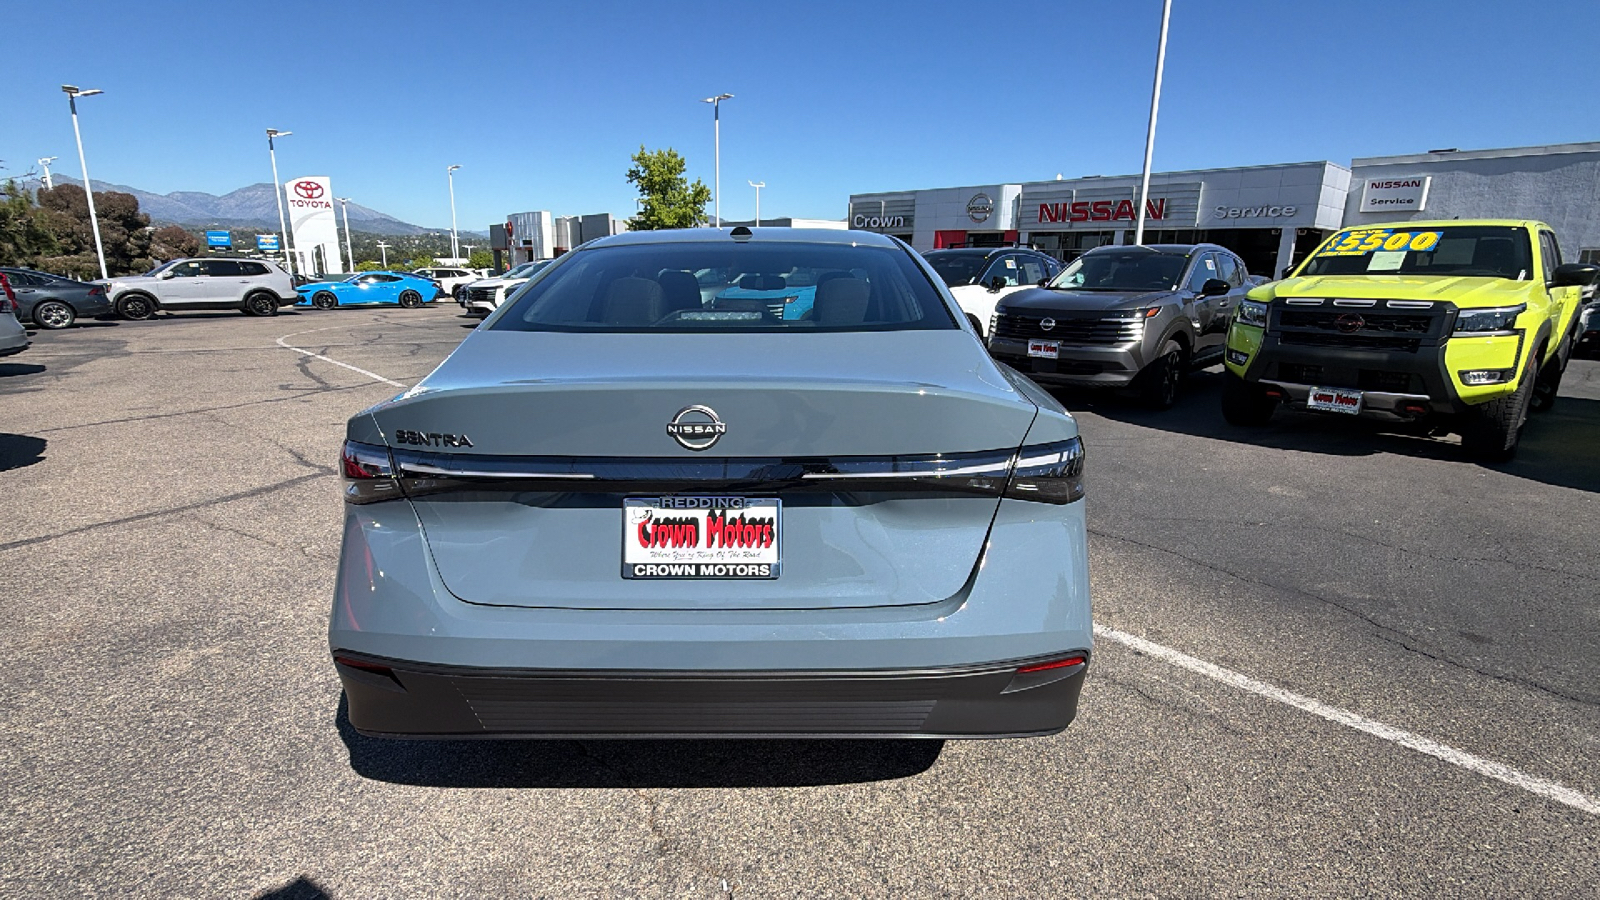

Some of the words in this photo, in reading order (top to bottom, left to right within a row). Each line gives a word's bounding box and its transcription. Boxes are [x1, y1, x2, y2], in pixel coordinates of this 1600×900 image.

[1371, 180, 1421, 189] NISSAN
[290, 199, 332, 209] TOYOTA
[1370, 197, 1414, 206] Service
[1038, 197, 1166, 223] NISSAN
[1214, 203, 1297, 219] Service
[854, 213, 904, 228] Crown
[668, 425, 726, 434] NISSAN
[396, 429, 474, 448] SENTRA
[661, 497, 743, 508] REDDING
[638, 516, 700, 548] Crown
[706, 510, 775, 548] Motors
[650, 551, 671, 559] Where
[697, 551, 714, 560] King
[728, 551, 740, 559] The
[743, 551, 761, 559] Road
[634, 564, 696, 576] CROWN
[701, 564, 770, 576] MOTORS
